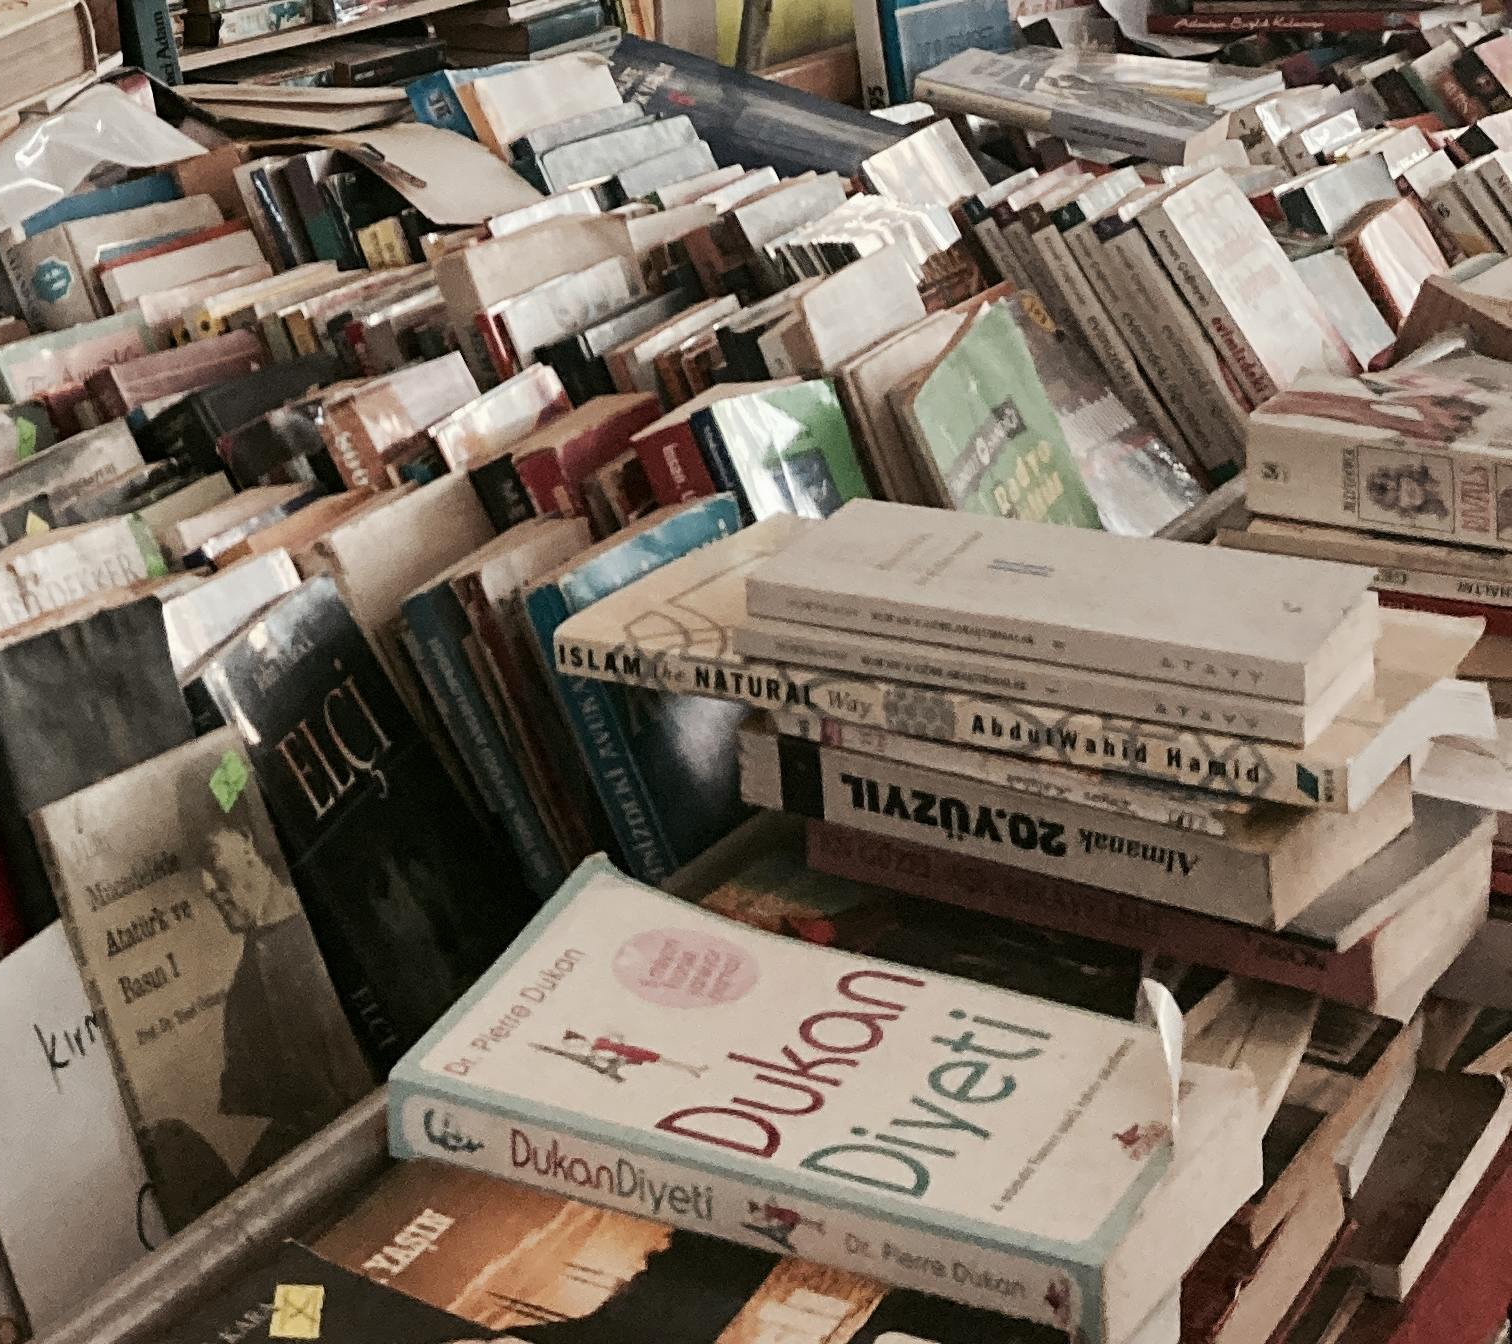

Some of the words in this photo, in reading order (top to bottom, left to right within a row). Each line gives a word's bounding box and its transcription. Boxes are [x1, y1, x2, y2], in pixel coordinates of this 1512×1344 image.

[153, 10, 168, 60] Adam
[558, 643, 642, 678] ISLAM
[694, 665, 817, 710] NATURAL
[826, 688, 874, 720] Way
[1166, 745, 1262, 785] Hamid
[1078, 824, 1201, 878] Almanak
[471, 1002, 532, 1051] Pierre
[519, 947, 586, 1004] Dukan
[654, 969, 926, 1160] Dukan
[799, 1008, 1053, 1199] Diyeti
[951, 1260, 1027, 1298] Dukan
